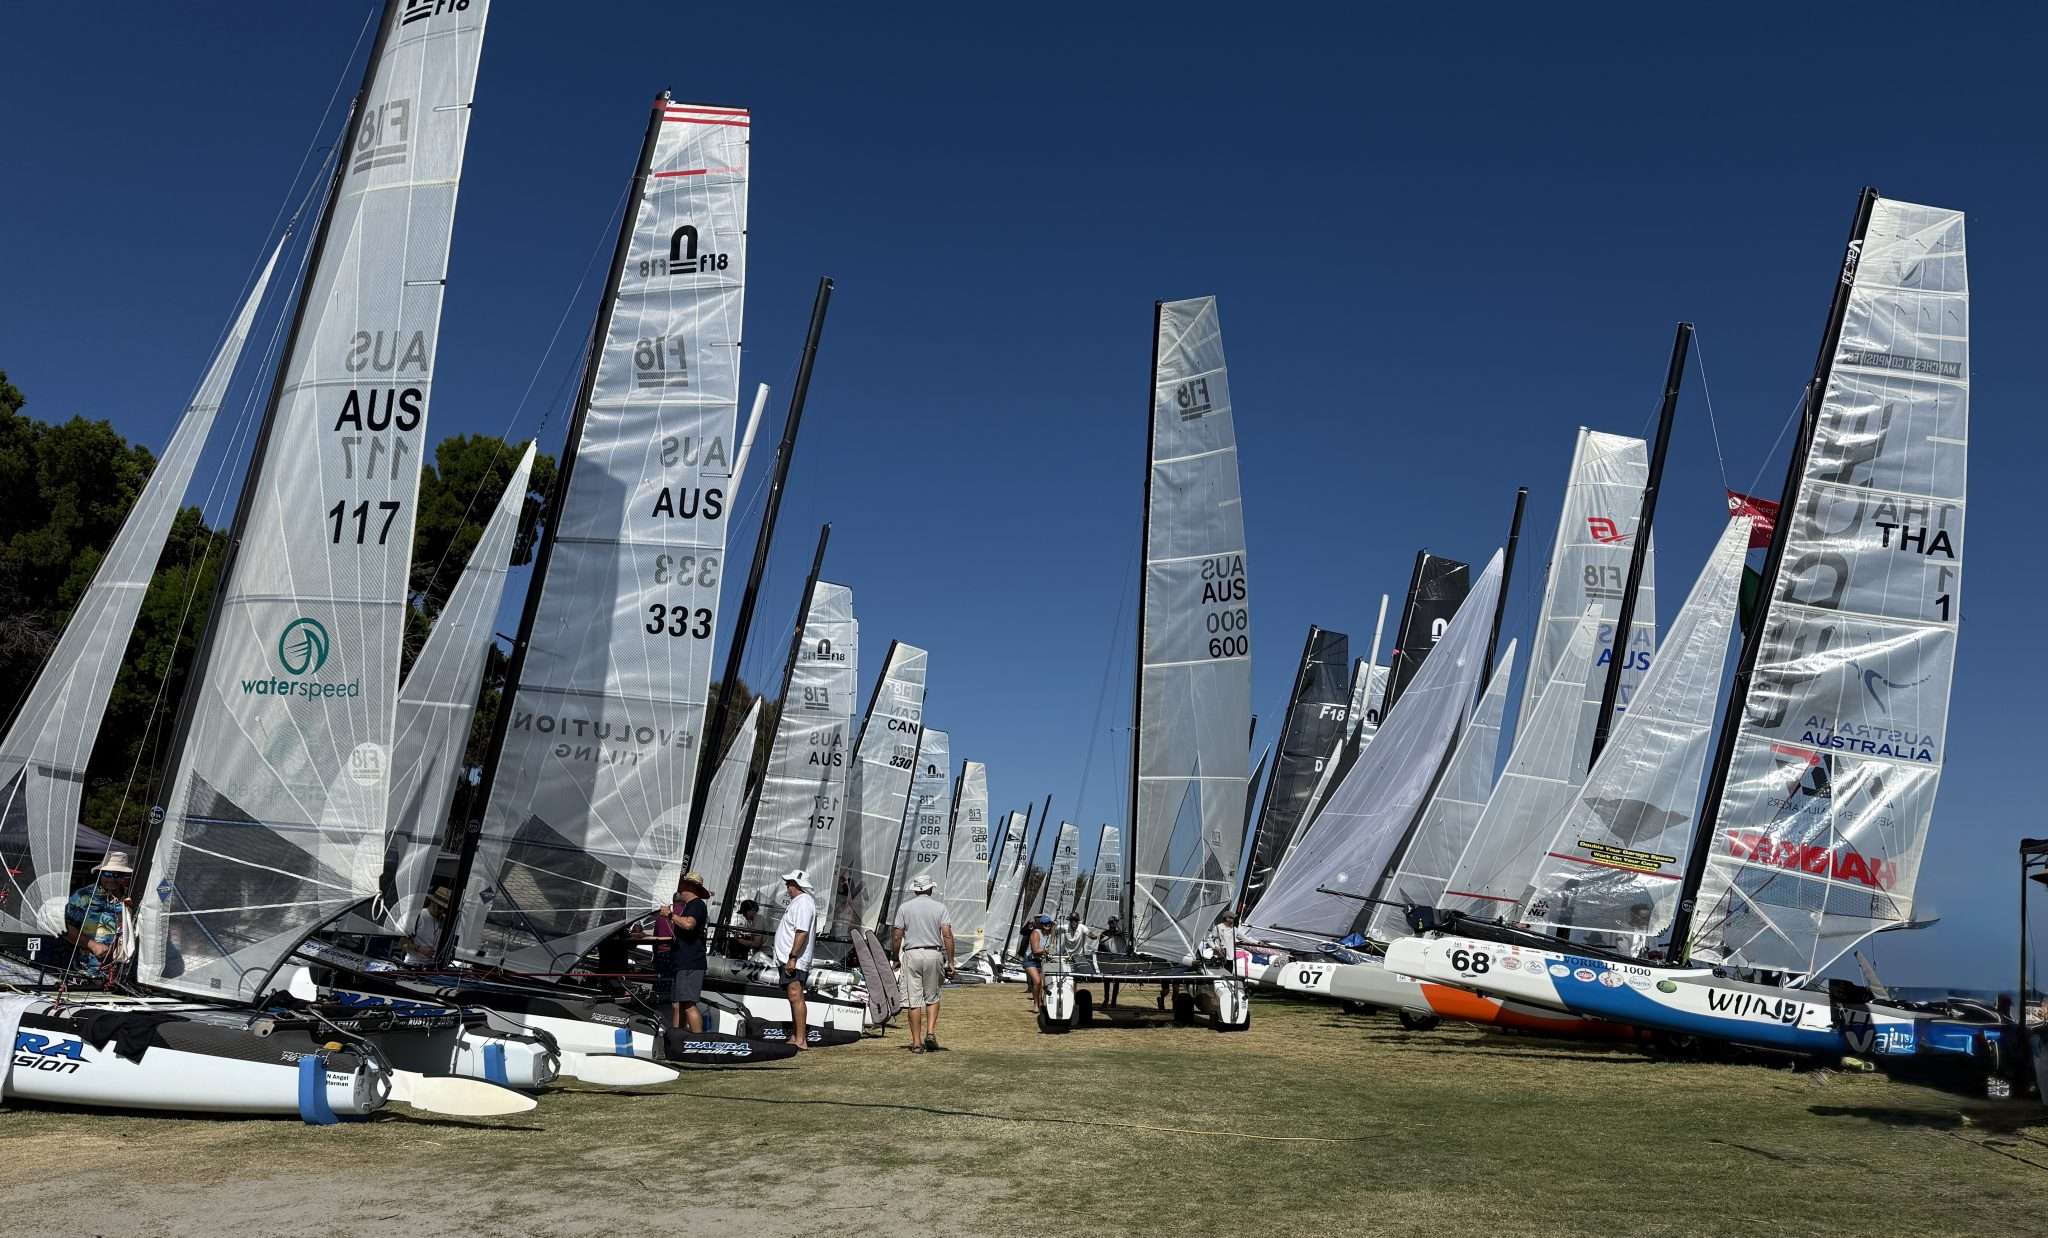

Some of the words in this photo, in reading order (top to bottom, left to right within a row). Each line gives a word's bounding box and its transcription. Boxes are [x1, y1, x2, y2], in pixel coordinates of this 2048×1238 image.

[335, 388, 422, 432] AUS
[652, 487, 723, 520] AUS
[328, 500, 400, 545] 117
[1875, 521, 1956, 559] THA
[1201, 578, 1247, 604] AUS
[1935, 594, 1950, 621] 1
[645, 603, 714, 640] 333
[1208, 635, 1249, 658] 600
[241, 677, 360, 702] waterspeed
[1319, 705, 1346, 722] F18
[887, 718, 918, 735] CAN
[1801, 731, 1932, 761] AUSTRALIA
[809, 751, 843, 767] AUS
[889, 756, 913, 770] 330
[807, 815, 835, 831] 157
[920, 826, 941, 836] GBR
[971, 834, 988, 843] GER
[917, 853, 939, 863] 067
[975, 853, 988, 861] 40
[1579, 841, 1604, 850] Double
[1605, 846, 1621, 854] Your
[1622, 849, 1649, 859] Garage
[1650, 854, 1675, 862] Space
[1451, 949, 1490, 974] 68
[1624, 965, 1652, 977] 1000
[1299, 970, 1323, 985] 07
